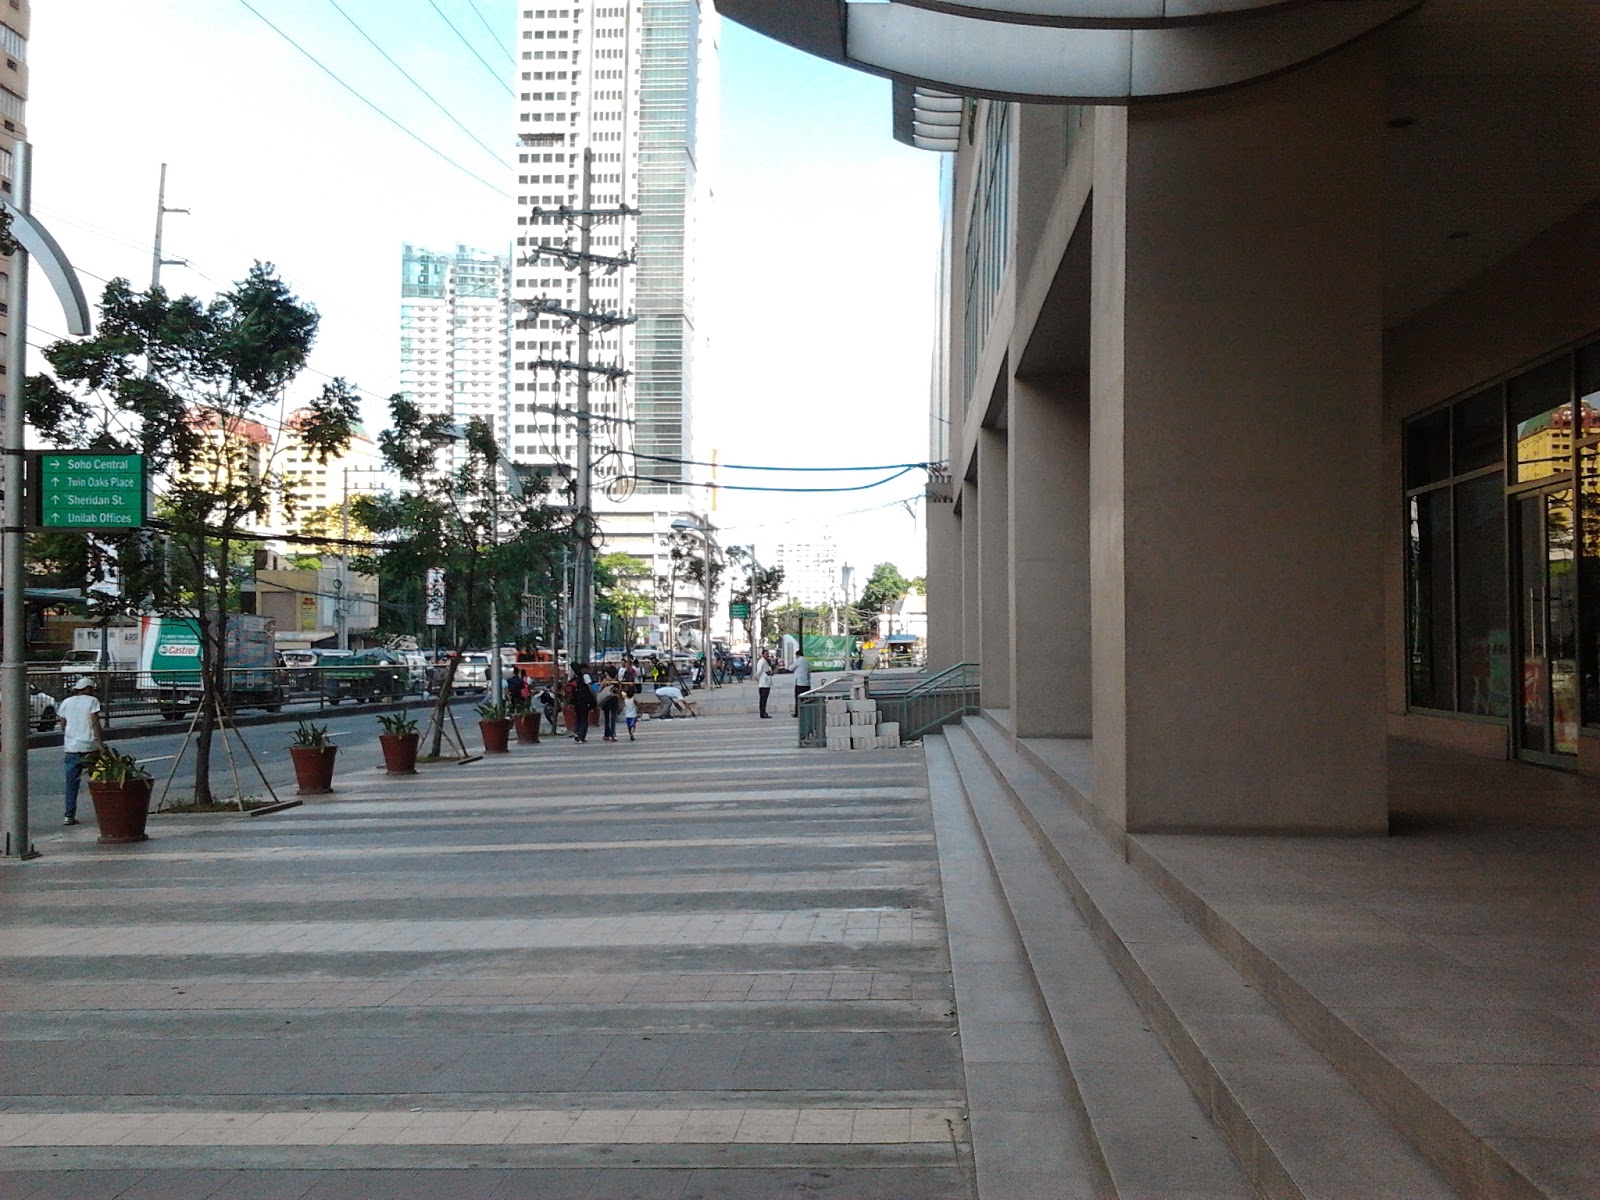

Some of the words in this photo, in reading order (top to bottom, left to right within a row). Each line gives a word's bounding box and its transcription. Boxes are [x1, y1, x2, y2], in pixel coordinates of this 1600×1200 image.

[67, 459, 91, 469] Soho
[94, 459, 128, 469] Central
[67, 477, 86, 487] Twin
[88, 477, 109, 487] Oaks
[111, 477, 134, 487] Place
[67, 495, 110, 505] Sheridan
[111, 495, 125, 505] St.
[67, 513, 96, 523] Unilab
[99, 513, 132, 523] Offices
[168, 646, 196, 654] Castrol
